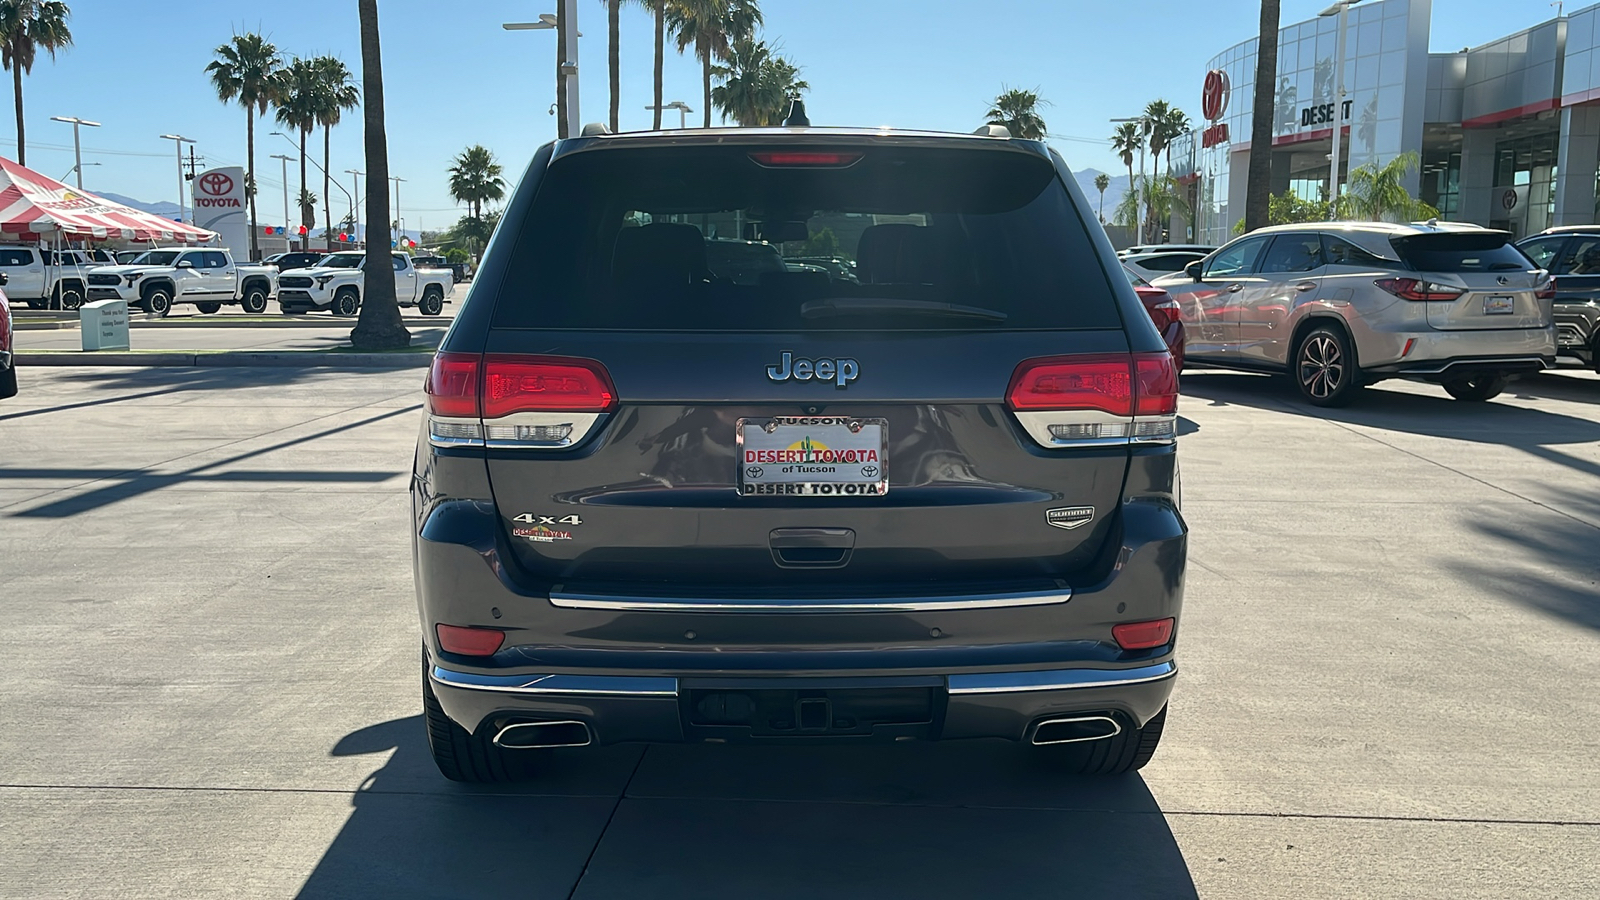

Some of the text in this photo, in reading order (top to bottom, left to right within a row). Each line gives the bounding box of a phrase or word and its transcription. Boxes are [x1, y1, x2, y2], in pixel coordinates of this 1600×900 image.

[194, 198, 241, 208] TOYOTA
[766, 351, 860, 387] Jeep
[776, 417, 848, 426] TUCSON
[745, 450, 878, 464] DESERT TOYOTA
[782, 465, 836, 473] of Tucson
[744, 484, 878, 495] DESERT TOYOTA
[1050, 509, 1092, 517] SUMMIT
[512, 512, 583, 526] 4x4
